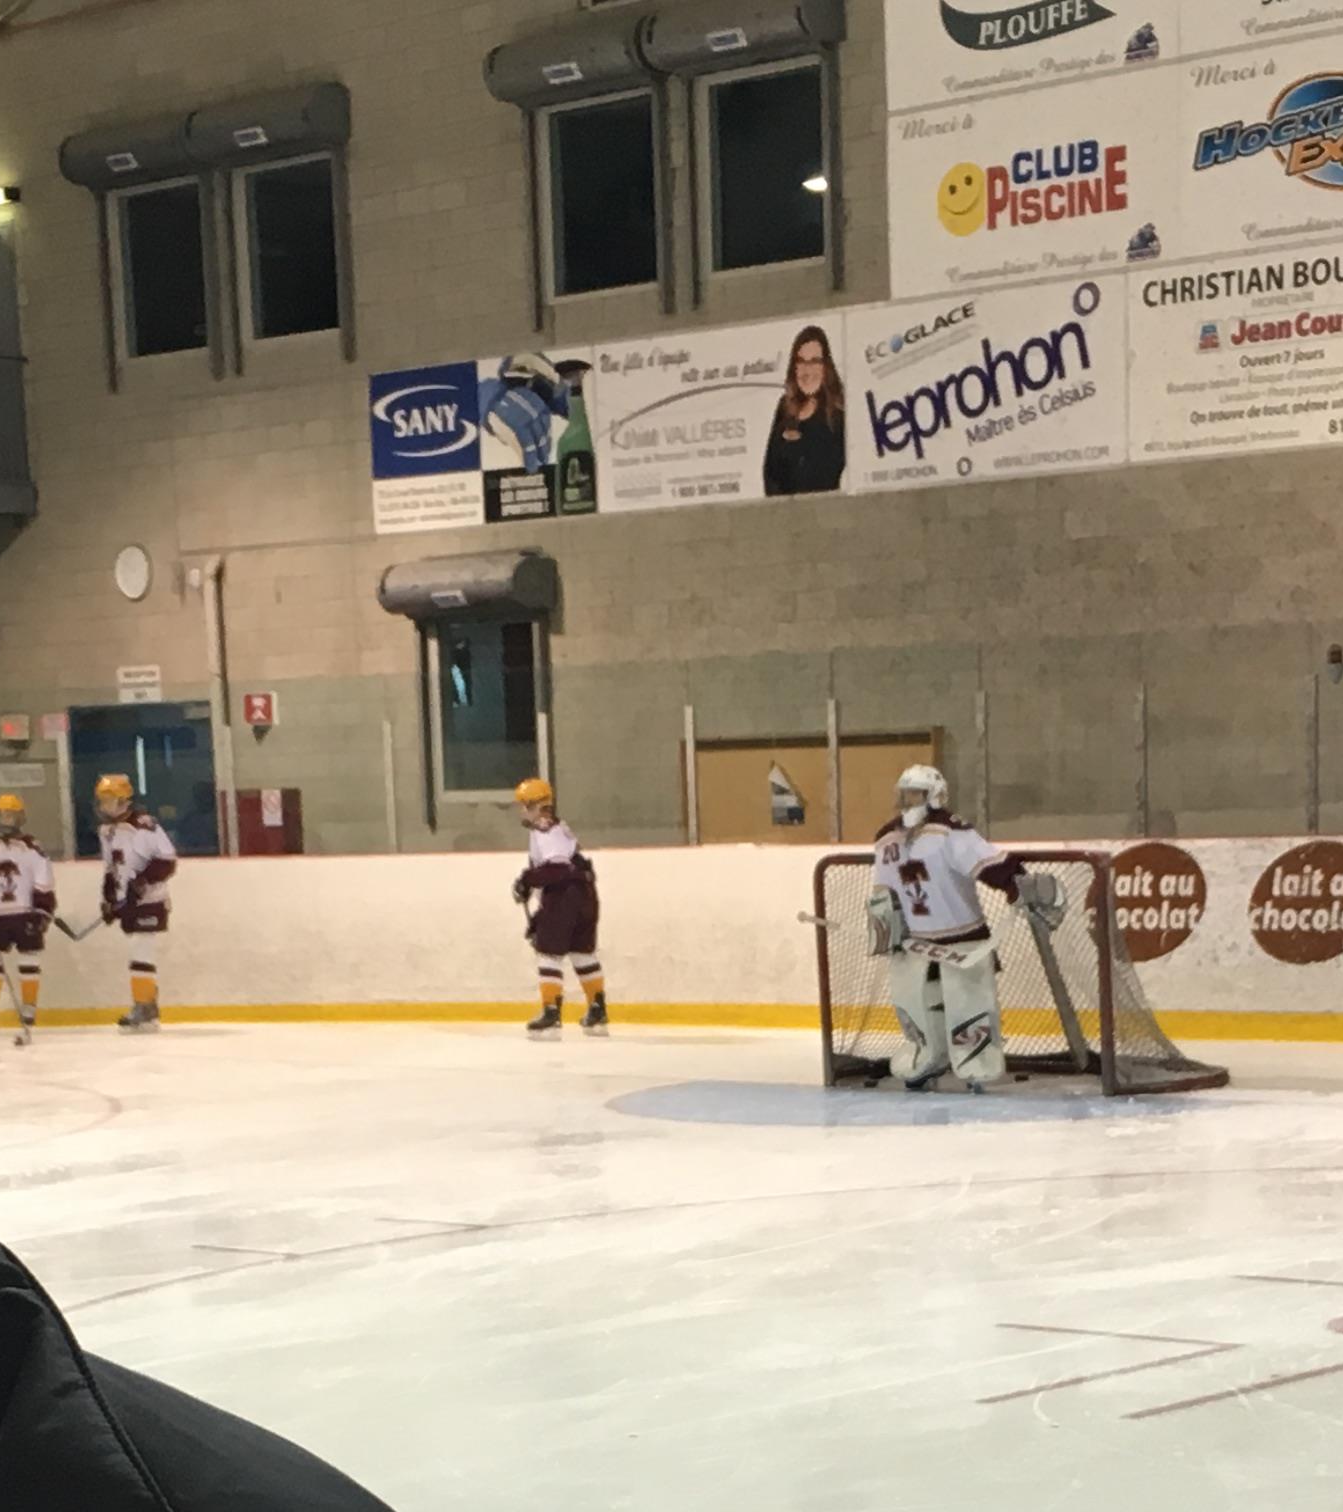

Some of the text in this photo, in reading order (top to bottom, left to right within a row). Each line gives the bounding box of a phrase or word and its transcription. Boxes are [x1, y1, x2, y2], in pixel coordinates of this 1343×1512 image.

[978, 0, 1089, 45] PLOUFFE
[1190, 64, 1256, 87] Merci
[1012, 140, 1099, 184] CLUB
[986, 145, 1128, 231] PISCINE
[1142, 263, 1284, 307] CHRISTIAN
[1240, 354, 1281, 368] Ouvert
[1293, 349, 1325, 365] jours
[865, 321, 1091, 460] leprohon
[1038, 380, 1097, 416] Celsius
[393, 404, 458, 438] SANY
[1160, 873, 1195, 897] au
[1272, 864, 1324, 896] lait
